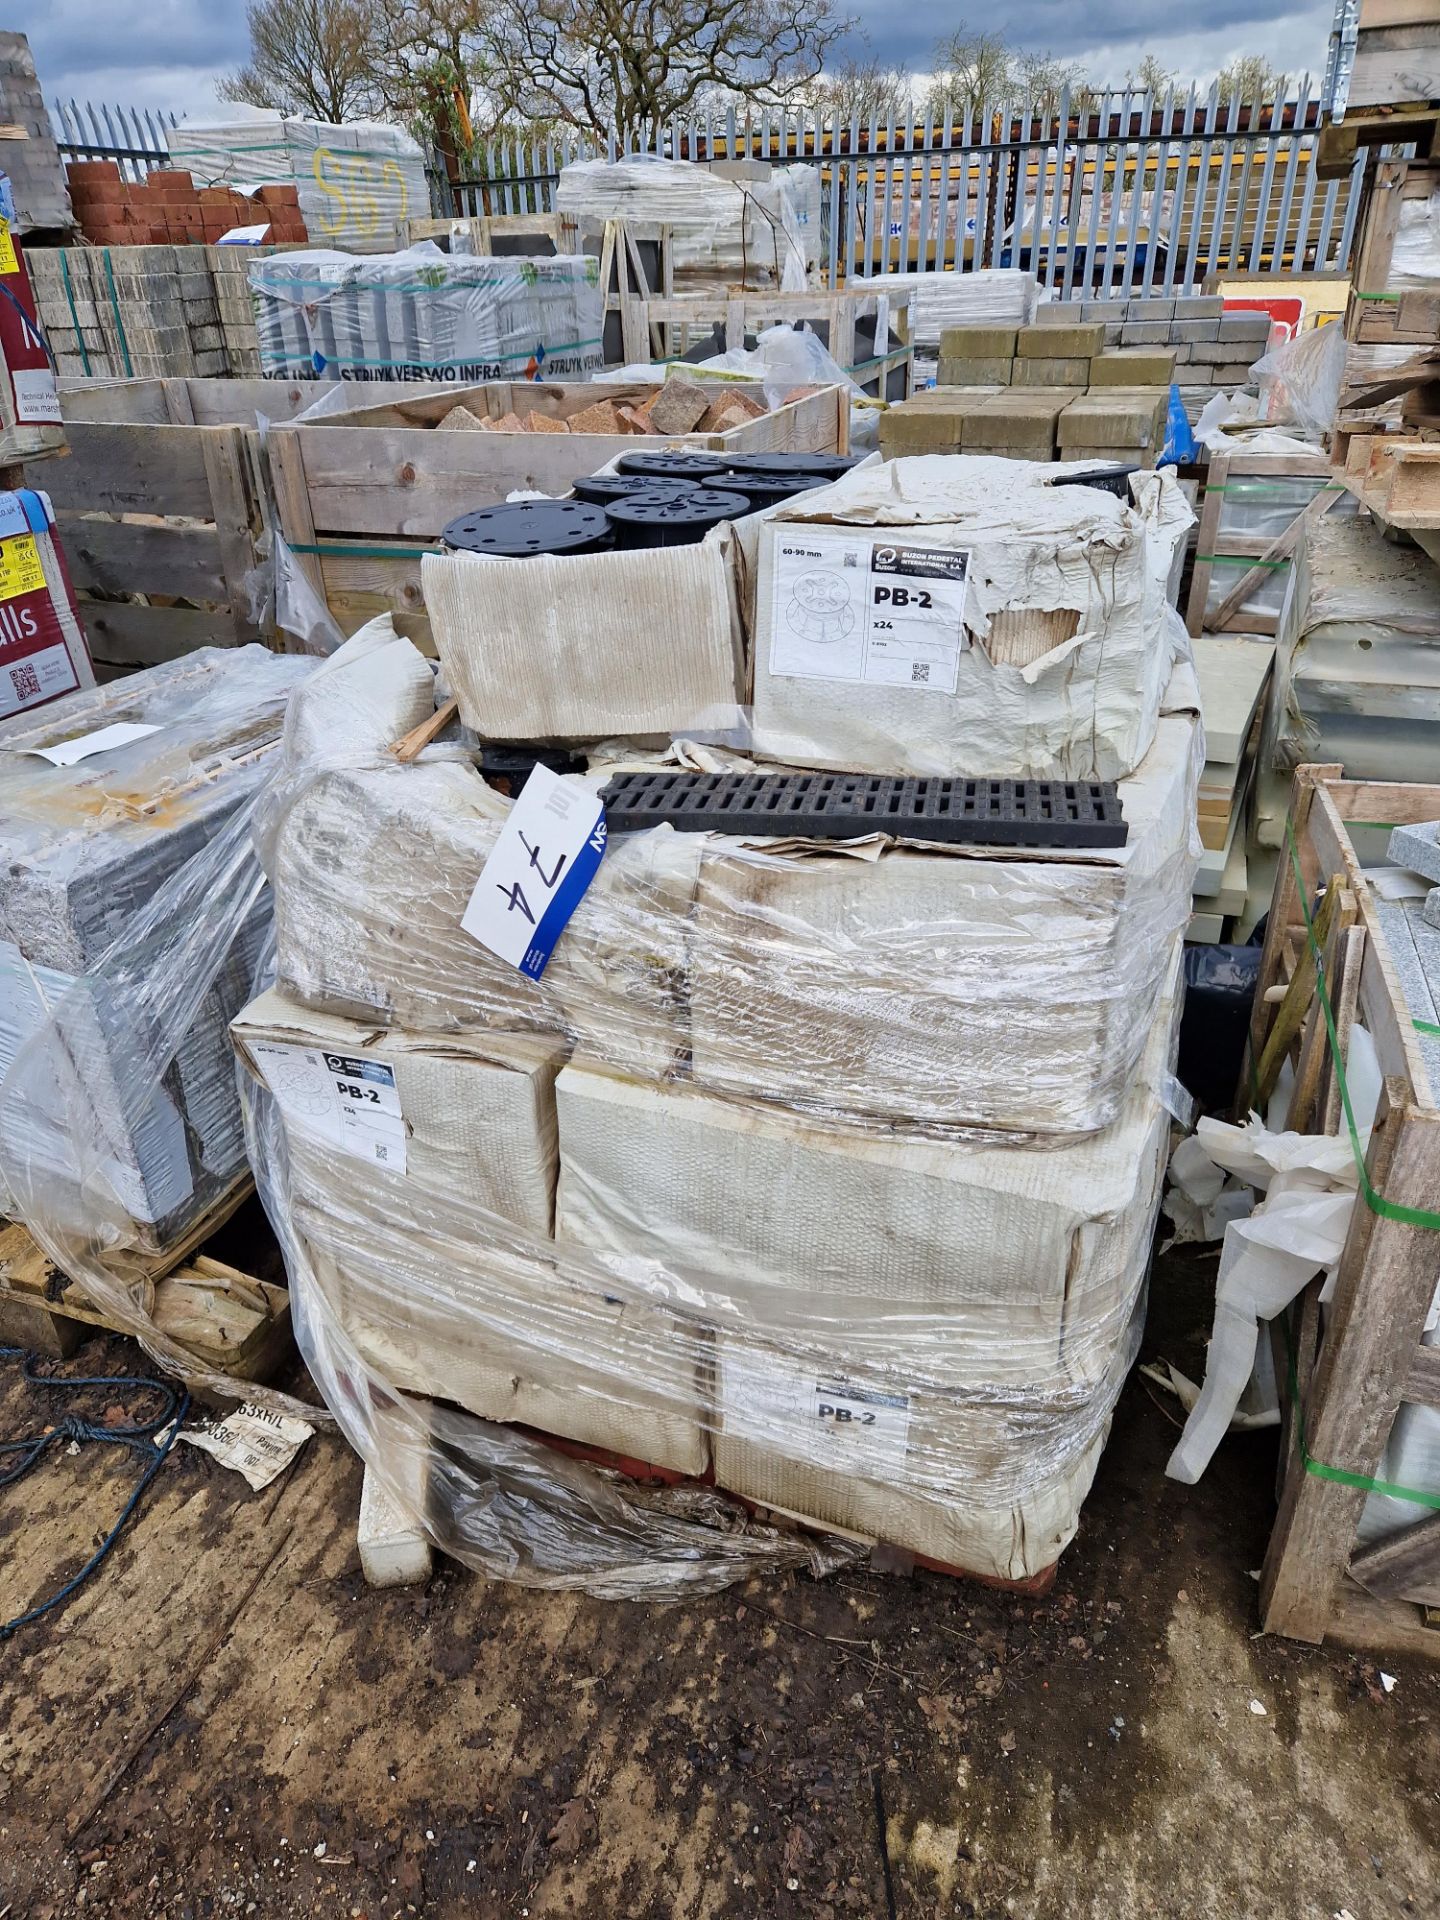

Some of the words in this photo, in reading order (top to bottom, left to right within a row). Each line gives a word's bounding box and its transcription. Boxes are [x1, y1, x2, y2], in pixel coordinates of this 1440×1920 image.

[341, 368, 394, 382] STRUYK
[460, 364, 501, 381] INFRA
[548, 356, 582, 374] STRUYK
[782, 548, 806, 557] 60-90
[807, 550, 822, 558] mm
[902, 551, 926, 561] BUZON
[927, 554, 963, 565] PEDESTAL
[901, 559, 948, 568] INTERNATIONAL
[873, 586, 933, 609] PB-2
[872, 620, 894, 630] x24
[496, 830, 567, 925] 74
[336, 1081, 381, 1104] PB-2
[818, 1403, 877, 1426] PB-2
